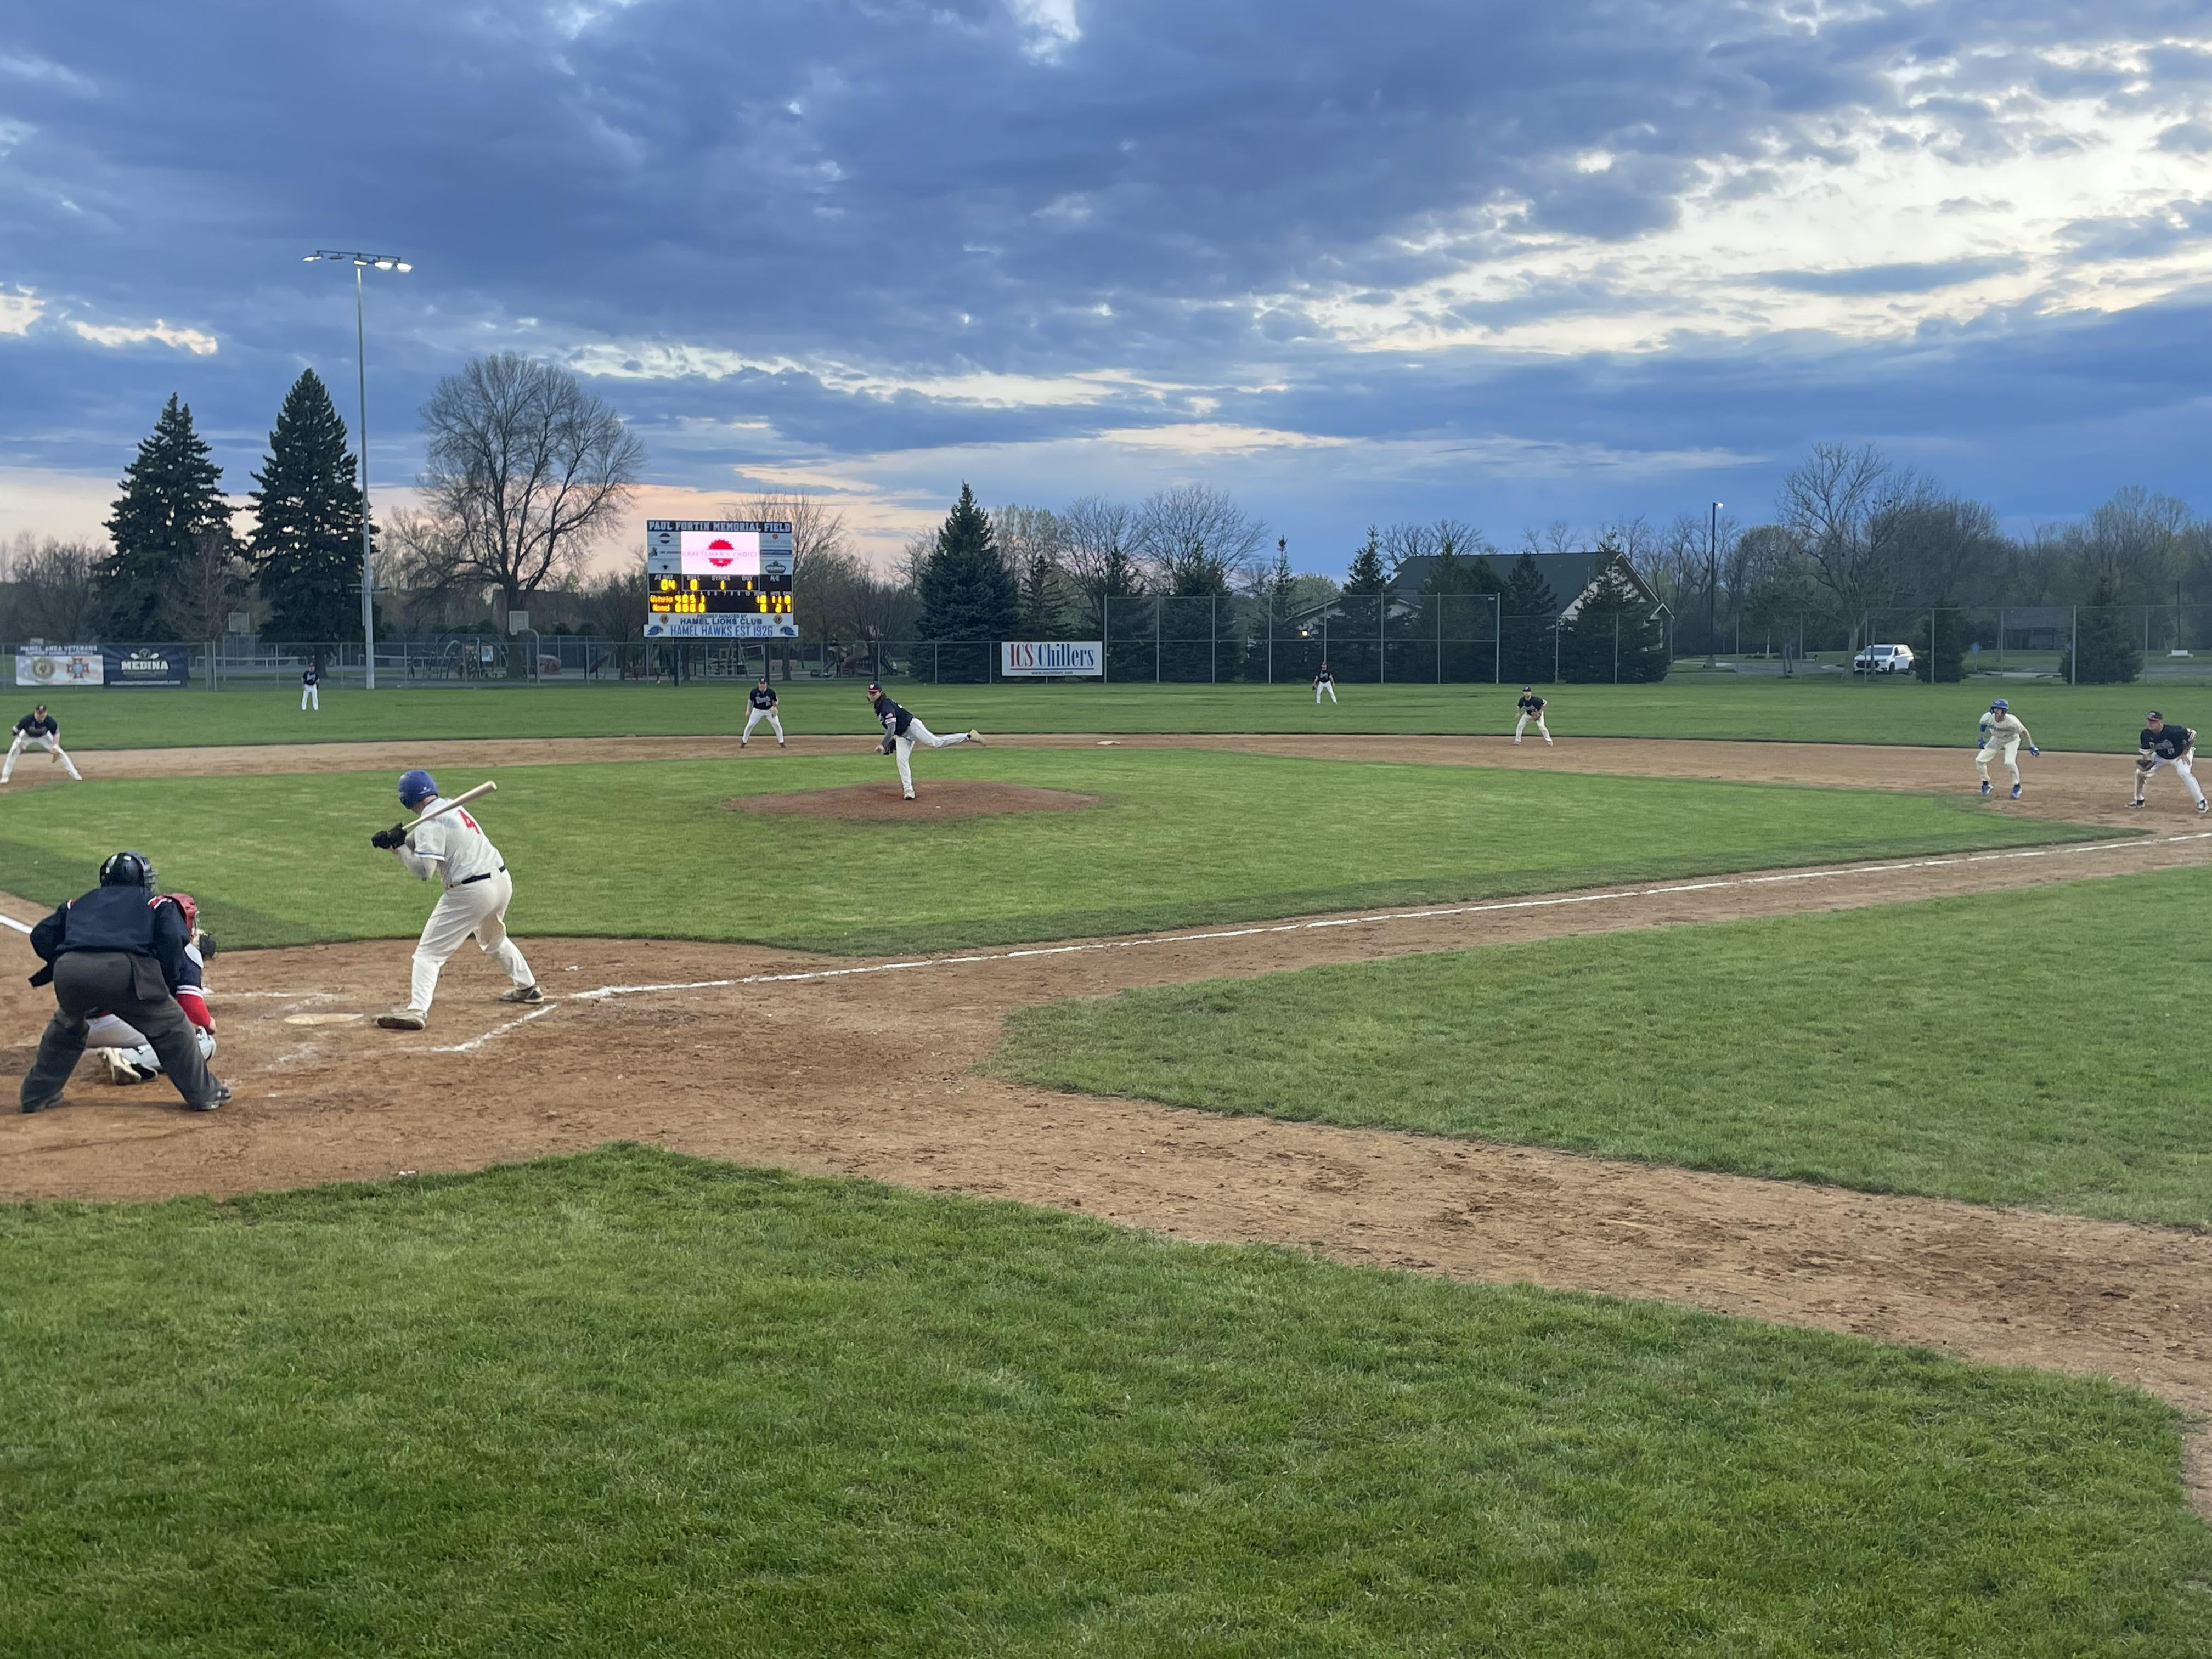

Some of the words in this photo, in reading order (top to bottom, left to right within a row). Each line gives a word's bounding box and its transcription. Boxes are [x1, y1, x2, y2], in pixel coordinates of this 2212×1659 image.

[649, 521, 673, 531] PAUL
[675, 522, 710, 531] FORTIN
[713, 522, 761, 532] MEMORIAL
[764, 523, 791, 532] FIELD
[661, 579, 676, 591] 04
[690, 579, 698, 591] 0
[720, 580, 725, 590] 1
[747, 580, 752, 590] 1
[682, 594, 689, 603] 0
[756, 595, 766, 603] 10
[784, 595, 791, 604] 0
[675, 603, 681, 613] 0
[682, 603, 689, 613] 0
[690, 603, 696, 613] 0
[698, 603, 705, 613] 0
[760, 603, 766, 613] 0
[775, 603, 782, 613] 2
[670, 625, 699, 636] HAMEL
[702, 625, 732, 636] HAWKS
[735, 625, 752, 636] EST
[754, 625, 773, 636] 1926
[1011, 643, 1034, 667] ICS
[1037, 643, 1094, 667] Chillers
[121, 660, 169, 670] MEDINA
[458, 809, 481, 834] 4
